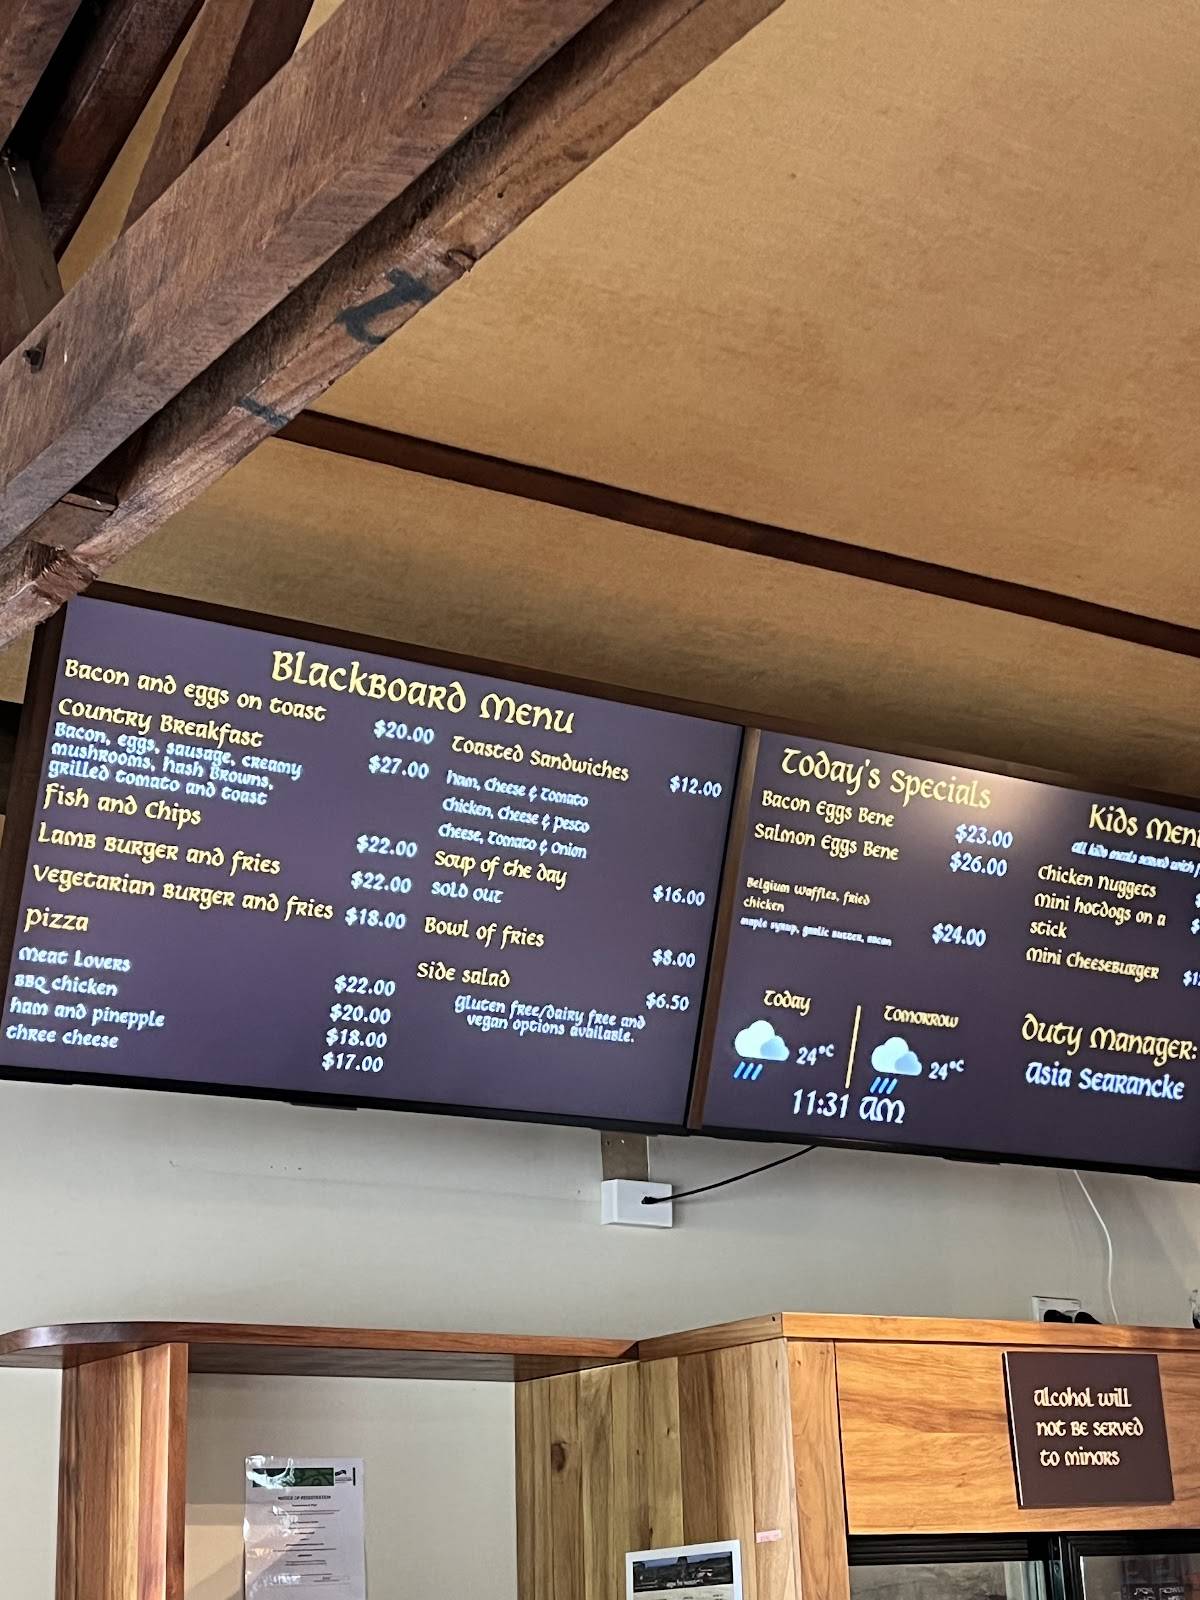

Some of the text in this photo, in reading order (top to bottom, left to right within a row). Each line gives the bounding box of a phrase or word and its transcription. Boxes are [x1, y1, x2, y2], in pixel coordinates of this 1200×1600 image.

[65, 659, 327, 721] Bacon and eggs on toast
[58, 698, 264, 748] Country Breakfast
[479, 693, 574, 734] Menu
[373, 719, 435, 745] $20.00
[51, 742, 156, 772] mushrooms,
[55, 722, 302, 779] Bacon, eggs, sausage, creamy
[452, 736, 524, 762] Toasted
[368, 755, 429, 779] $27.00
[782, 748, 990, 808] Today's Specials
[48, 760, 268, 805] grilled tomato and toast
[670, 775, 722, 798] $12.00
[97, 795, 138, 815] and
[145, 800, 201, 830] Chips
[762, 790, 810, 812] Bacon
[858, 807, 895, 827] Bene
[1089, 804, 1138, 836] Kids
[356, 834, 418, 858] $22.00
[754, 823, 815, 846] Salmon
[863, 841, 899, 860] Bene
[955, 824, 1013, 849] $23.00
[38, 822, 96, 849] Lamb
[186, 847, 224, 867] and
[230, 850, 280, 877] fries
[435, 851, 567, 891] Soup of the day
[949, 851, 1007, 877] $26.00
[1038, 864, 1093, 887] Chicken
[351, 871, 412, 893] $22.00
[747, 877, 790, 894] Belgium
[842, 891, 870, 906] fried
[242, 893, 279, 912] and
[284, 895, 333, 921] fries
[653, 885, 705, 906] $16.00
[743, 896, 784, 912] chicken
[345, 907, 407, 930] $18.00
[1074, 897, 1131, 926] hotdogs
[1136, 911, 1153, 924] on
[1157, 914, 1166, 926] a
[424, 917, 544, 950] Bowl of fries
[932, 923, 986, 947] $24.00
[1030, 920, 1067, 938] stick
[74, 950, 131, 972] Lovers
[652, 949, 695, 968] $8.00
[51, 975, 118, 996] chicken
[334, 975, 396, 997] $22.00
[417, 961, 510, 988] Side salad
[329, 1003, 391, 1025] $20.00
[646, 992, 689, 1011] $6.50
[764, 990, 811, 1016] Today
[54, 1003, 88, 1020] and
[91, 1006, 165, 1031] pinepple
[467, 1014, 513, 1032] vegan
[512, 1019, 565, 1036] options
[587, 1009, 617, 1029] free
[619, 1015, 646, 1031] and
[884, 1005, 959, 1028] Tomorrow
[6, 1023, 119, 1048] three cheese
[326, 1027, 387, 1048] $18.00
[1090, 1027, 1197, 1067] Manager:
[322, 1051, 383, 1072] $17.00
[1025, 1061, 1185, 1100] Asia Searancke
[794, 1089, 849, 1118] 11:31
[1097, 1388, 1132, 1407] will
[1036, 1417, 1143, 1436] not be served
[1040, 1446, 1120, 1466] to minors
